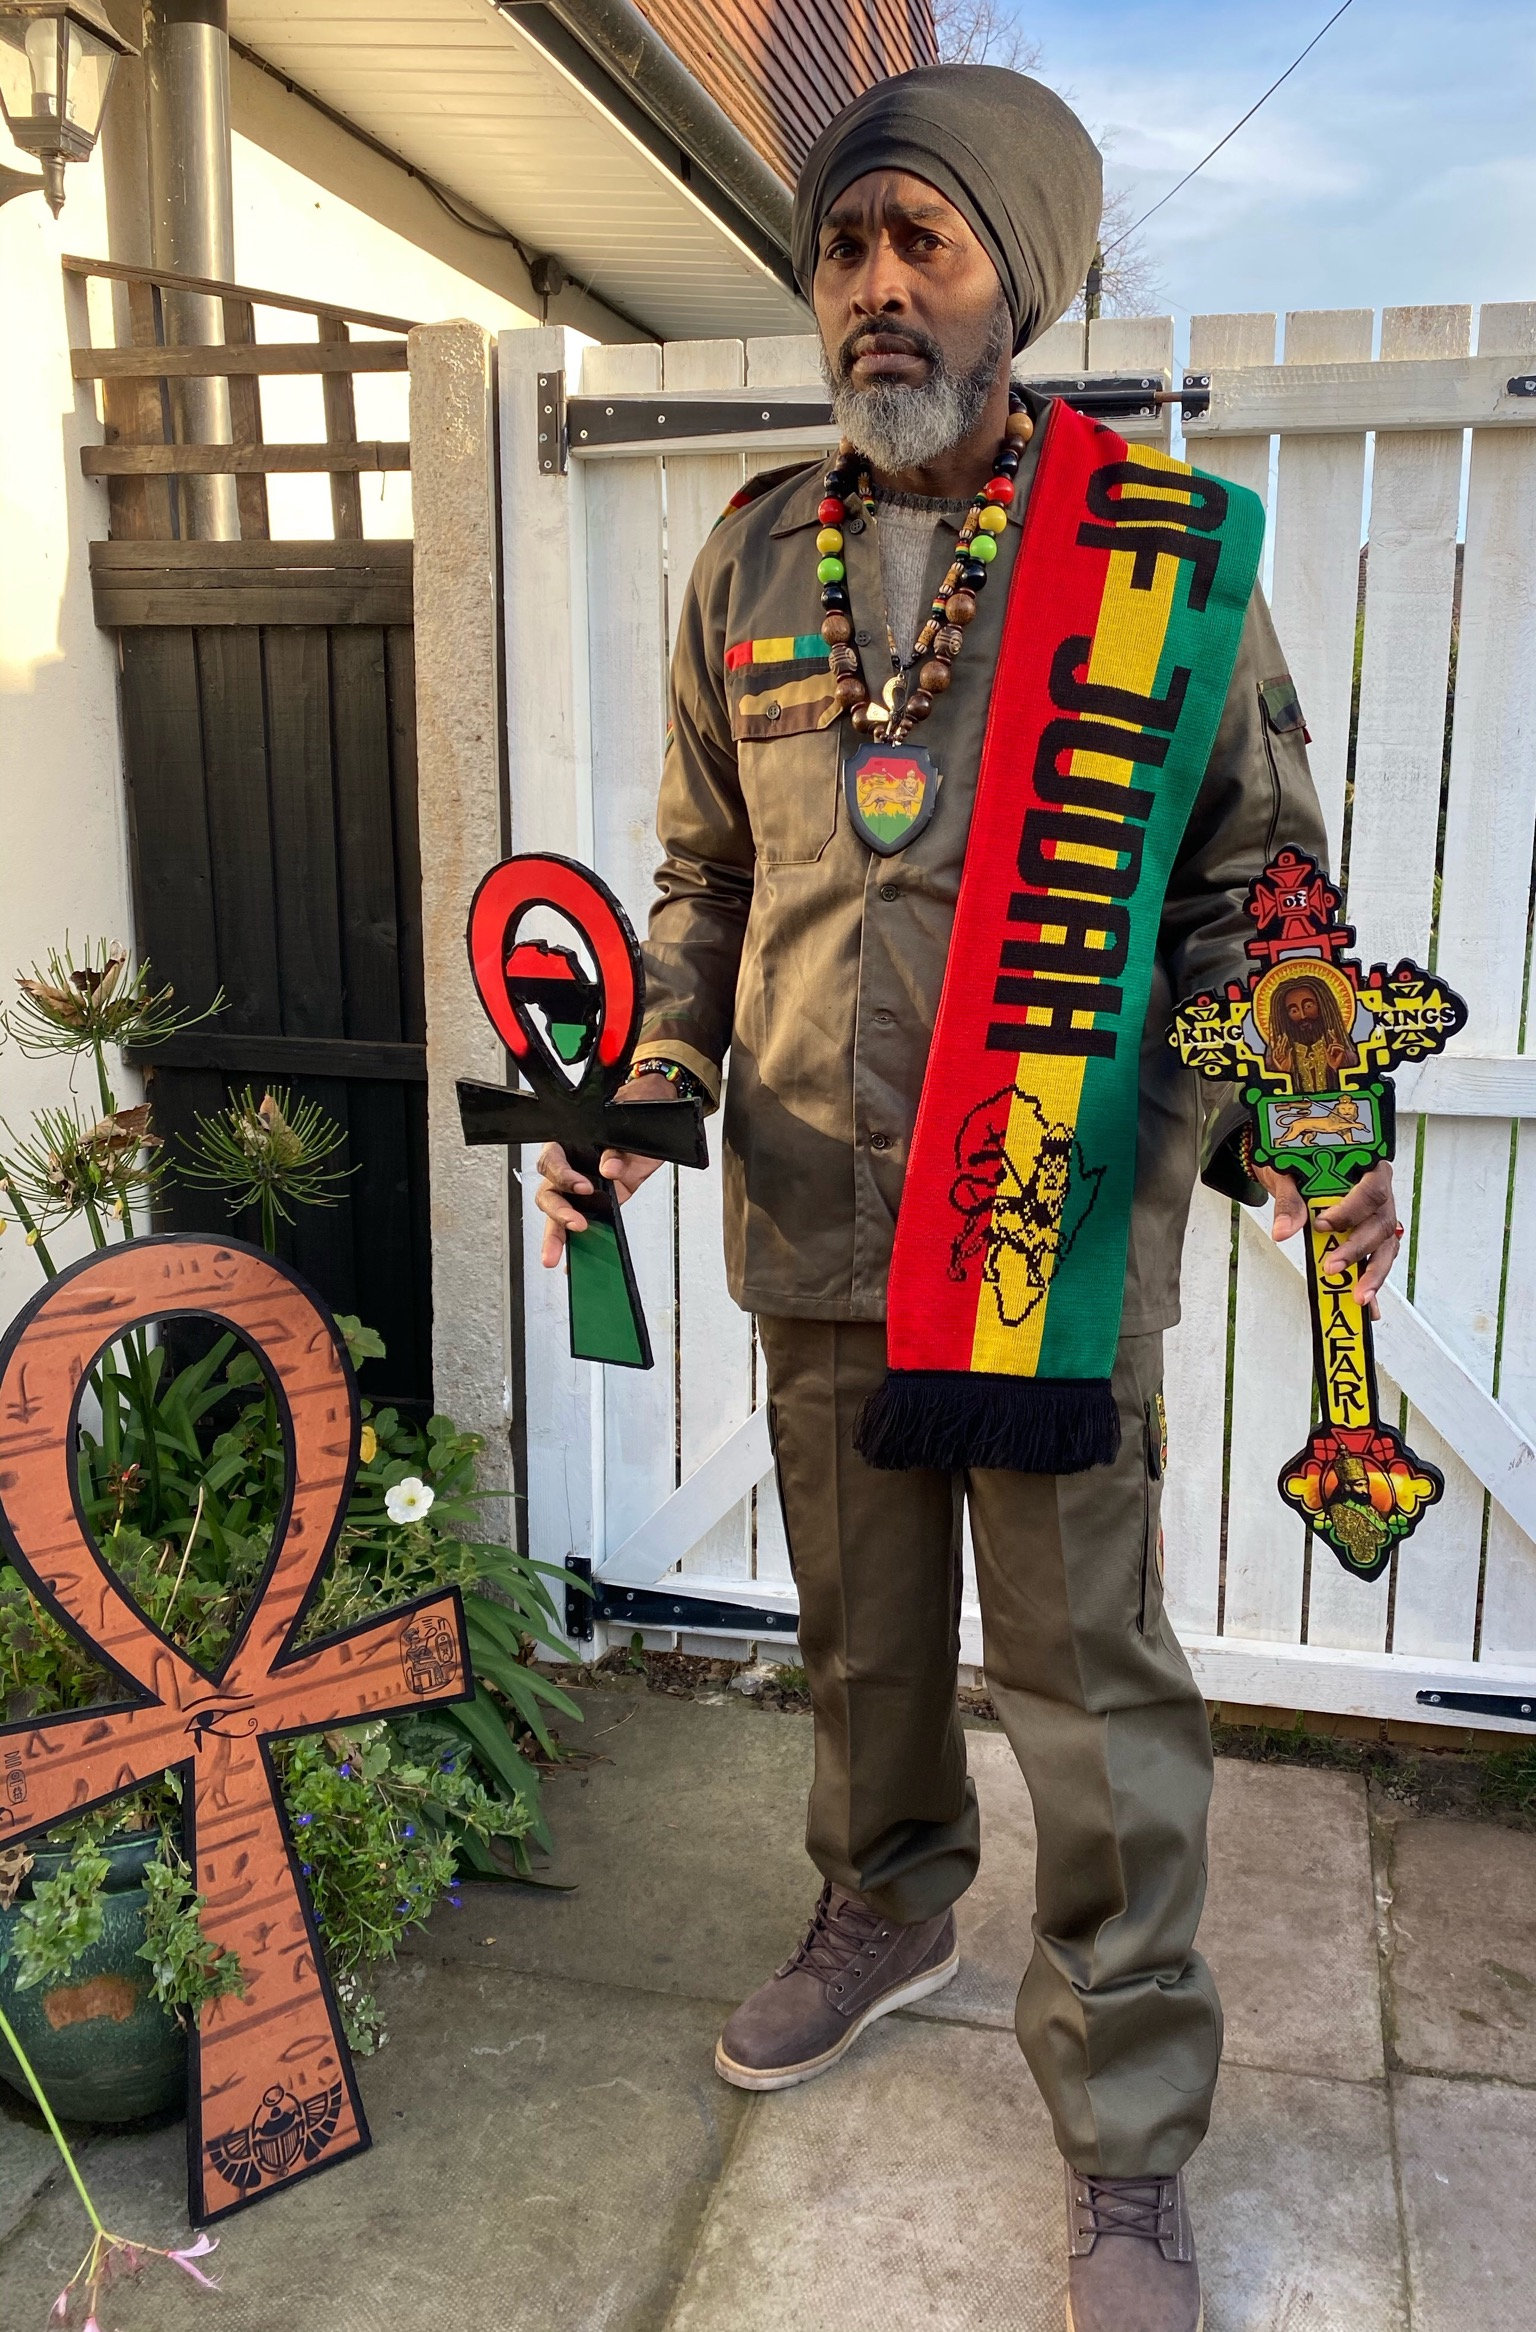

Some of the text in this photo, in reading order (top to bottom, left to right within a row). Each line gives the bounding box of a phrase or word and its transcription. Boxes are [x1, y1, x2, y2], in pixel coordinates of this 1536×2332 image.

[985, 461, 1229, 1061] OF JUDAH
[1181, 1023, 1245, 1046] KING
[1372, 1005, 1456, 1031] KINGS
